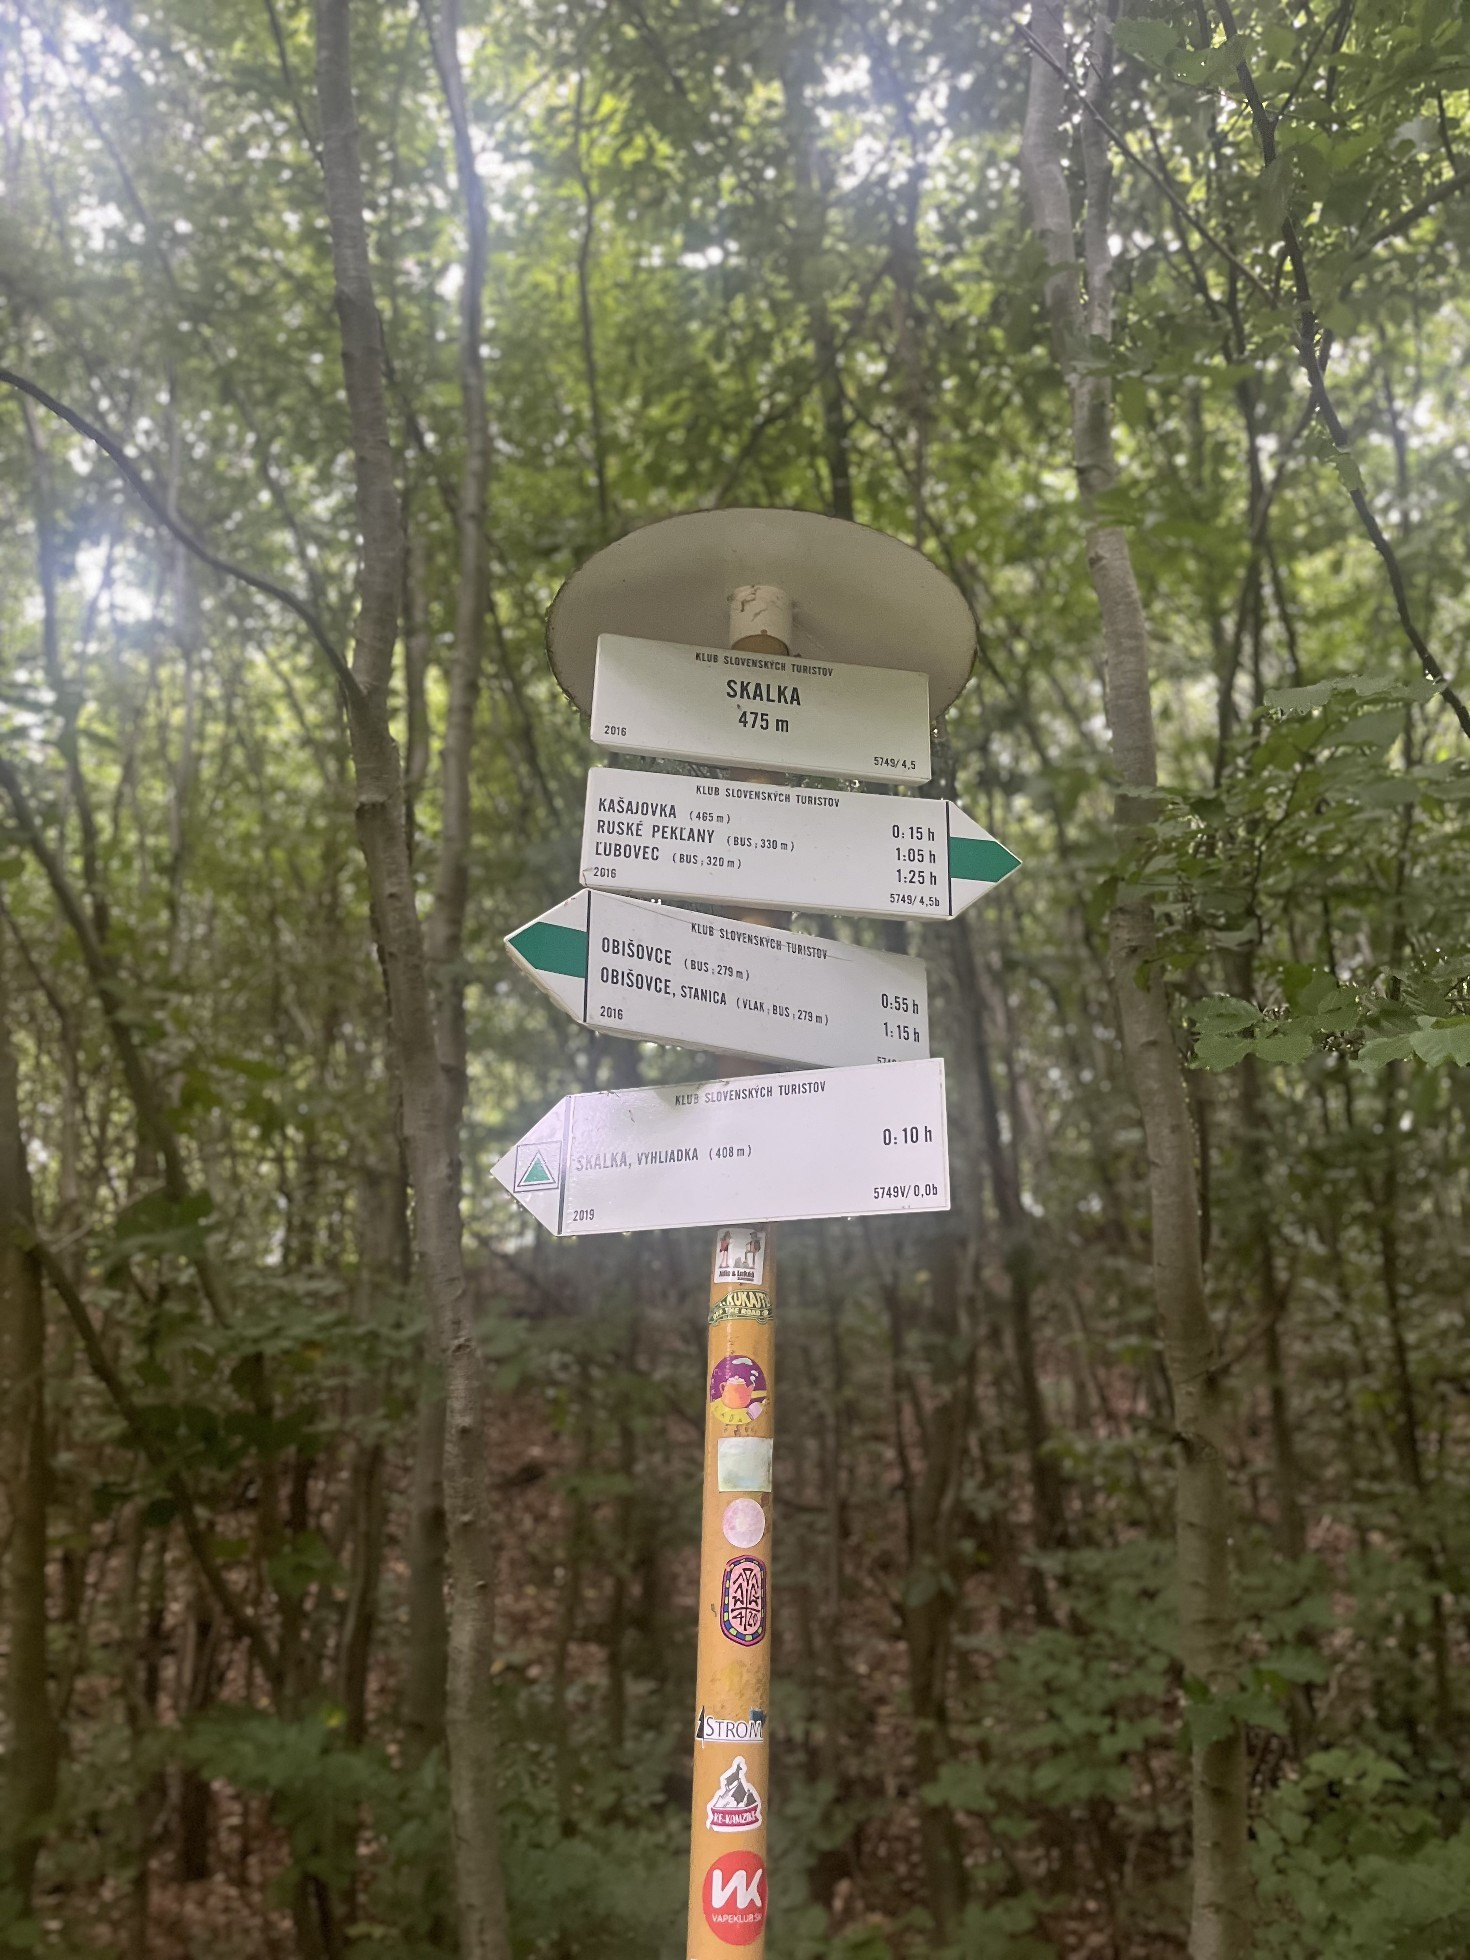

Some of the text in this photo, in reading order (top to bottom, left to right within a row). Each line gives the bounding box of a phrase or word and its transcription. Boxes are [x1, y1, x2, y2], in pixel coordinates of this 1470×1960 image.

[695, 652, 718, 663] KLUB
[791, 663, 833, 677] TURISTOV
[726, 679, 801, 706] SKALKA
[604, 724, 627, 737] 2016
[738, 710, 789, 733] 475 m
[696, 785, 840, 808] KLUB SLOVENSKÝCH TURISTOV
[598, 796, 677, 819] KAŠAJOVKA
[597, 819, 643, 837] RUSKÉ
[651, 824, 715, 844] PEKĽANY
[892, 824, 923, 841] 0:15
[595, 841, 660, 861] ĽUBOVEC
[895, 847, 925, 863] 1:05
[593, 866, 617, 879] 2016
[896, 868, 925, 885] 1:25
[601, 936, 672, 966] OBIŠOVCE
[691, 922, 828, 960] KLUB SLOVENSKÝCH TURISTOV
[600, 966, 676, 998] OBIŠOVCE,
[680, 985, 727, 1006] STANICA
[600, 1005, 624, 1020] 2016
[881, 993, 909, 1013] 0:55
[883, 1021, 910, 1041] 1:15
[675, 1081, 826, 1106] KLUB SLOVENSKÝCH TURISTOV
[883, 1126, 919, 1146] 0:10
[576, 1150, 631, 1171] SKALKA,
[637, 1147, 699, 1166] VYHLIADKA
[573, 1208, 595, 1222] 2019
